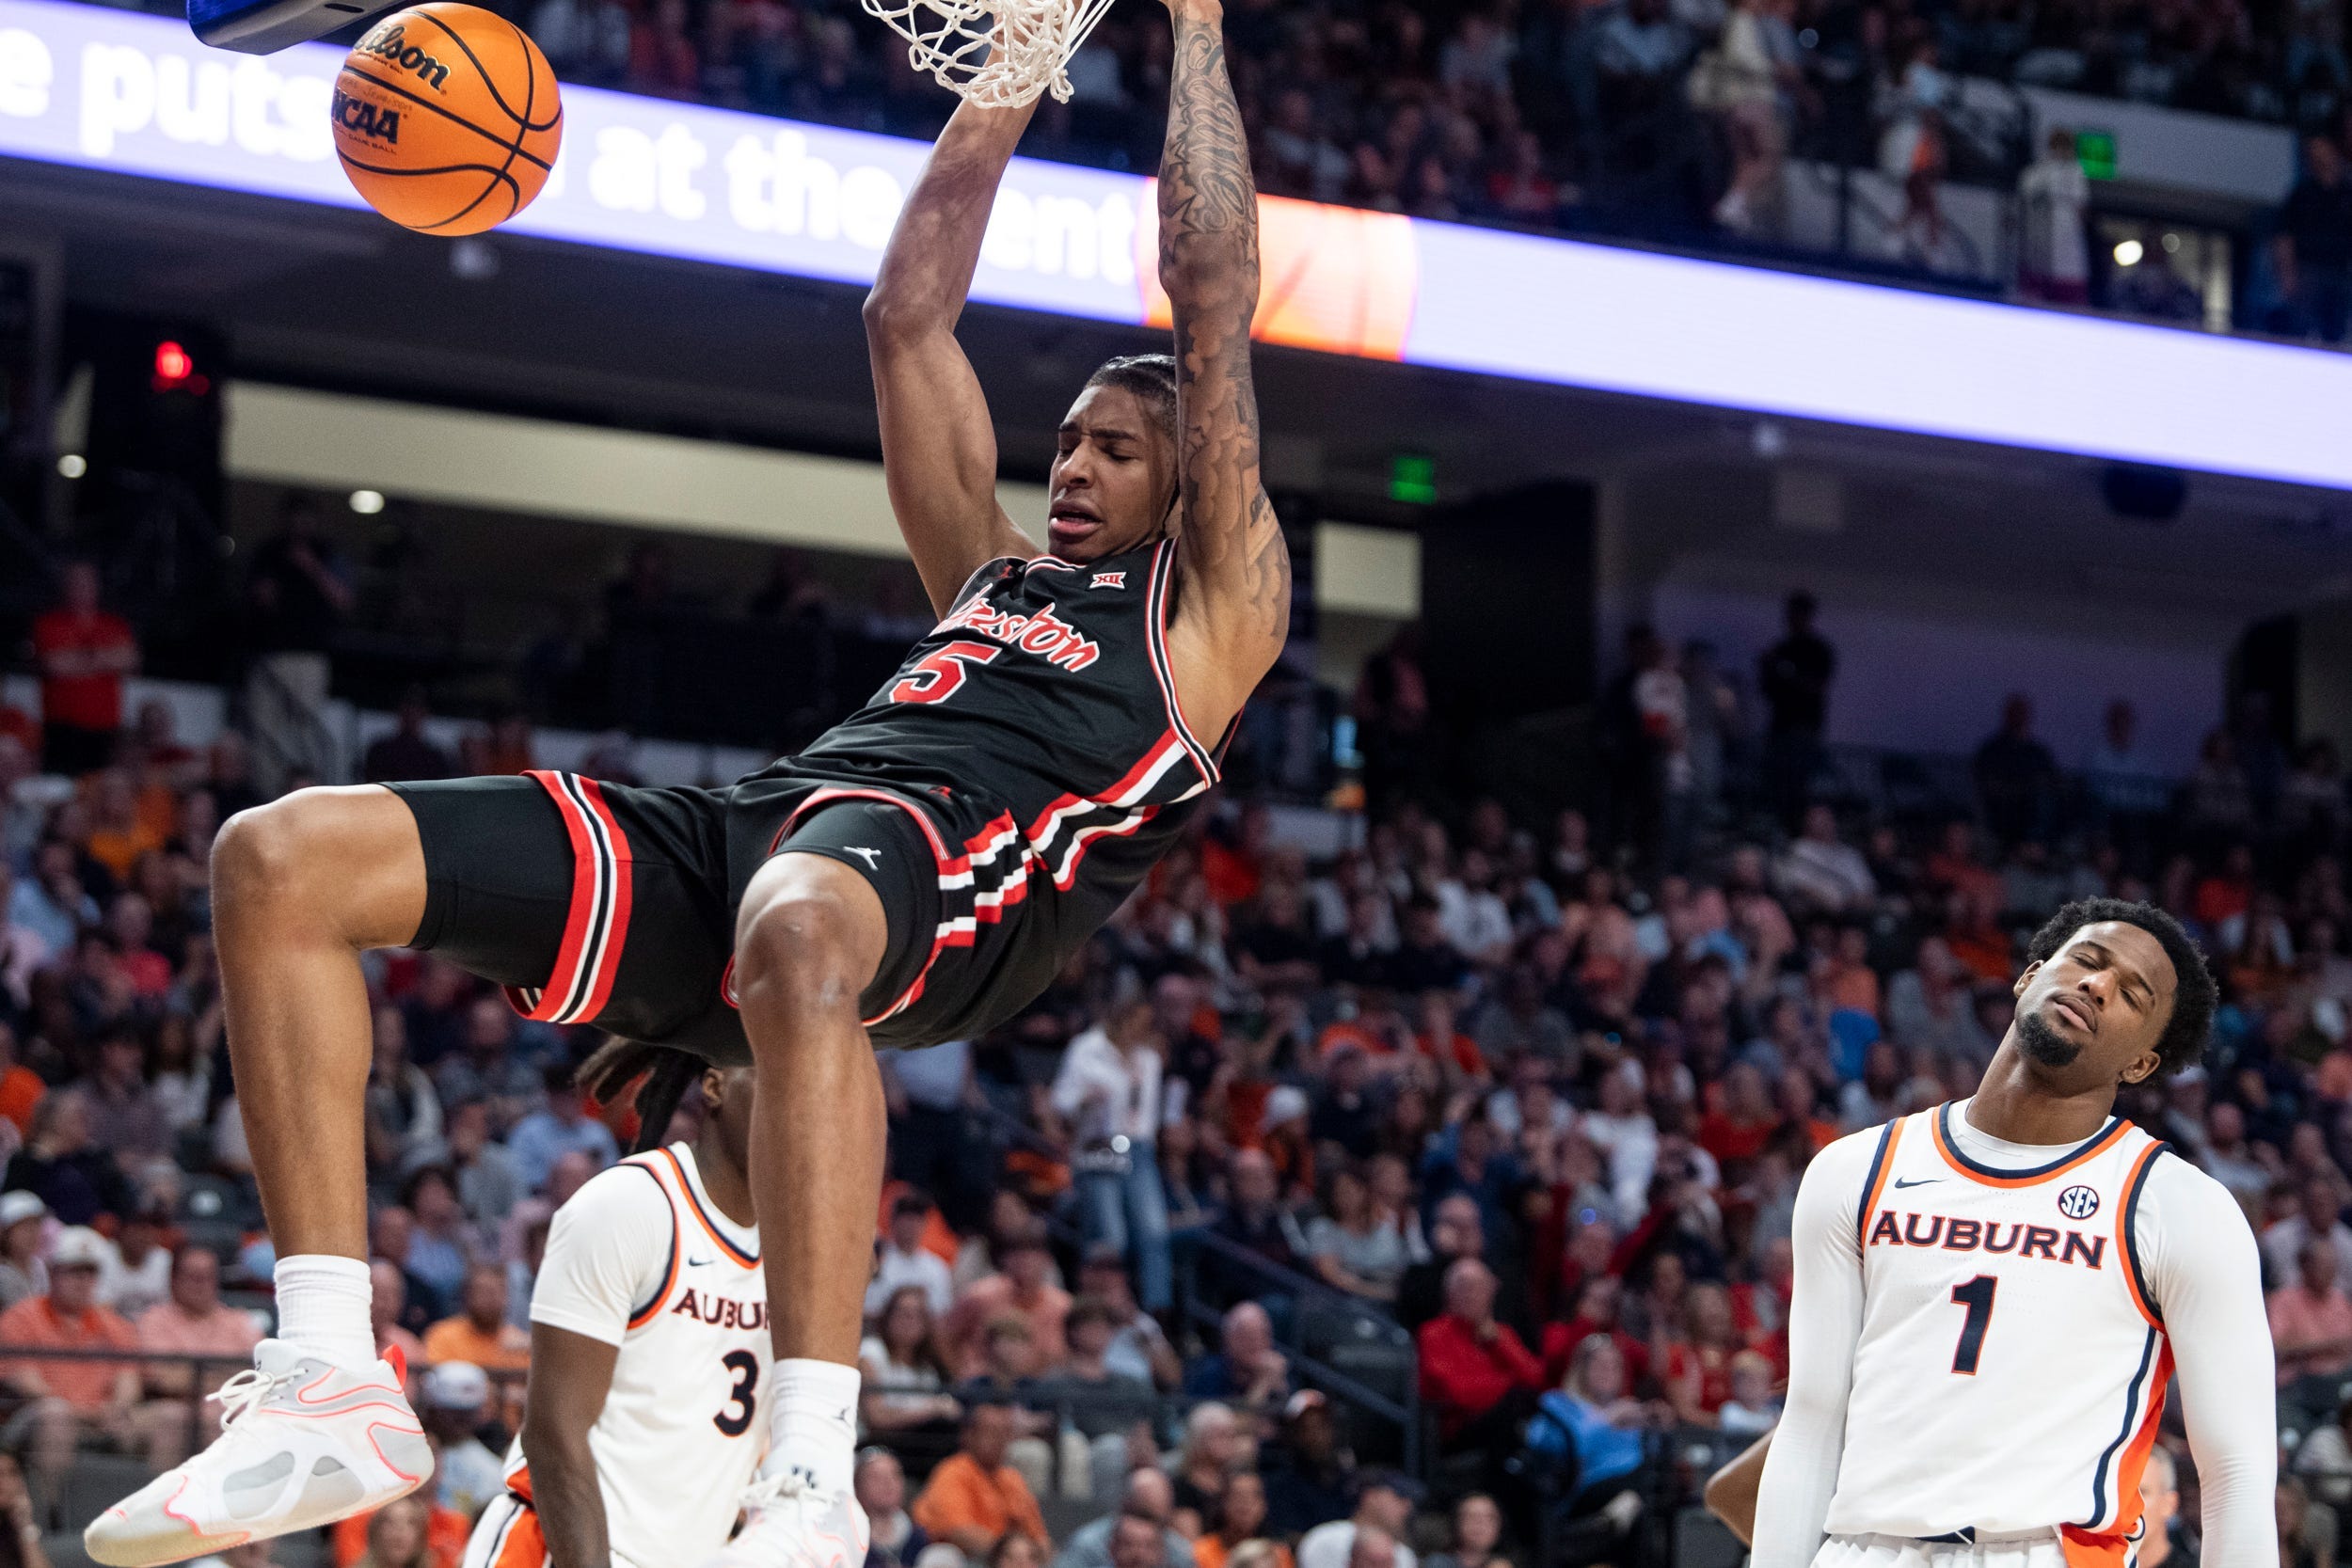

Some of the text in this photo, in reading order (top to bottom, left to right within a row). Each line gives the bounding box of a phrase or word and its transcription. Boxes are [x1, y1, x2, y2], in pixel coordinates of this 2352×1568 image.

[81, 42, 334, 156] puts
[590, 123, 707, 220] at
[724, 131, 904, 248] the
[889, 641, 1002, 705] 5
[2059, 1186, 2098, 1219] SEC
[1869, 1211, 2107, 1270] AUBURN
[672, 1287, 769, 1330] AUBU
[1950, 1275, 1997, 1375] 1
[713, 1350, 758, 1437] 3
